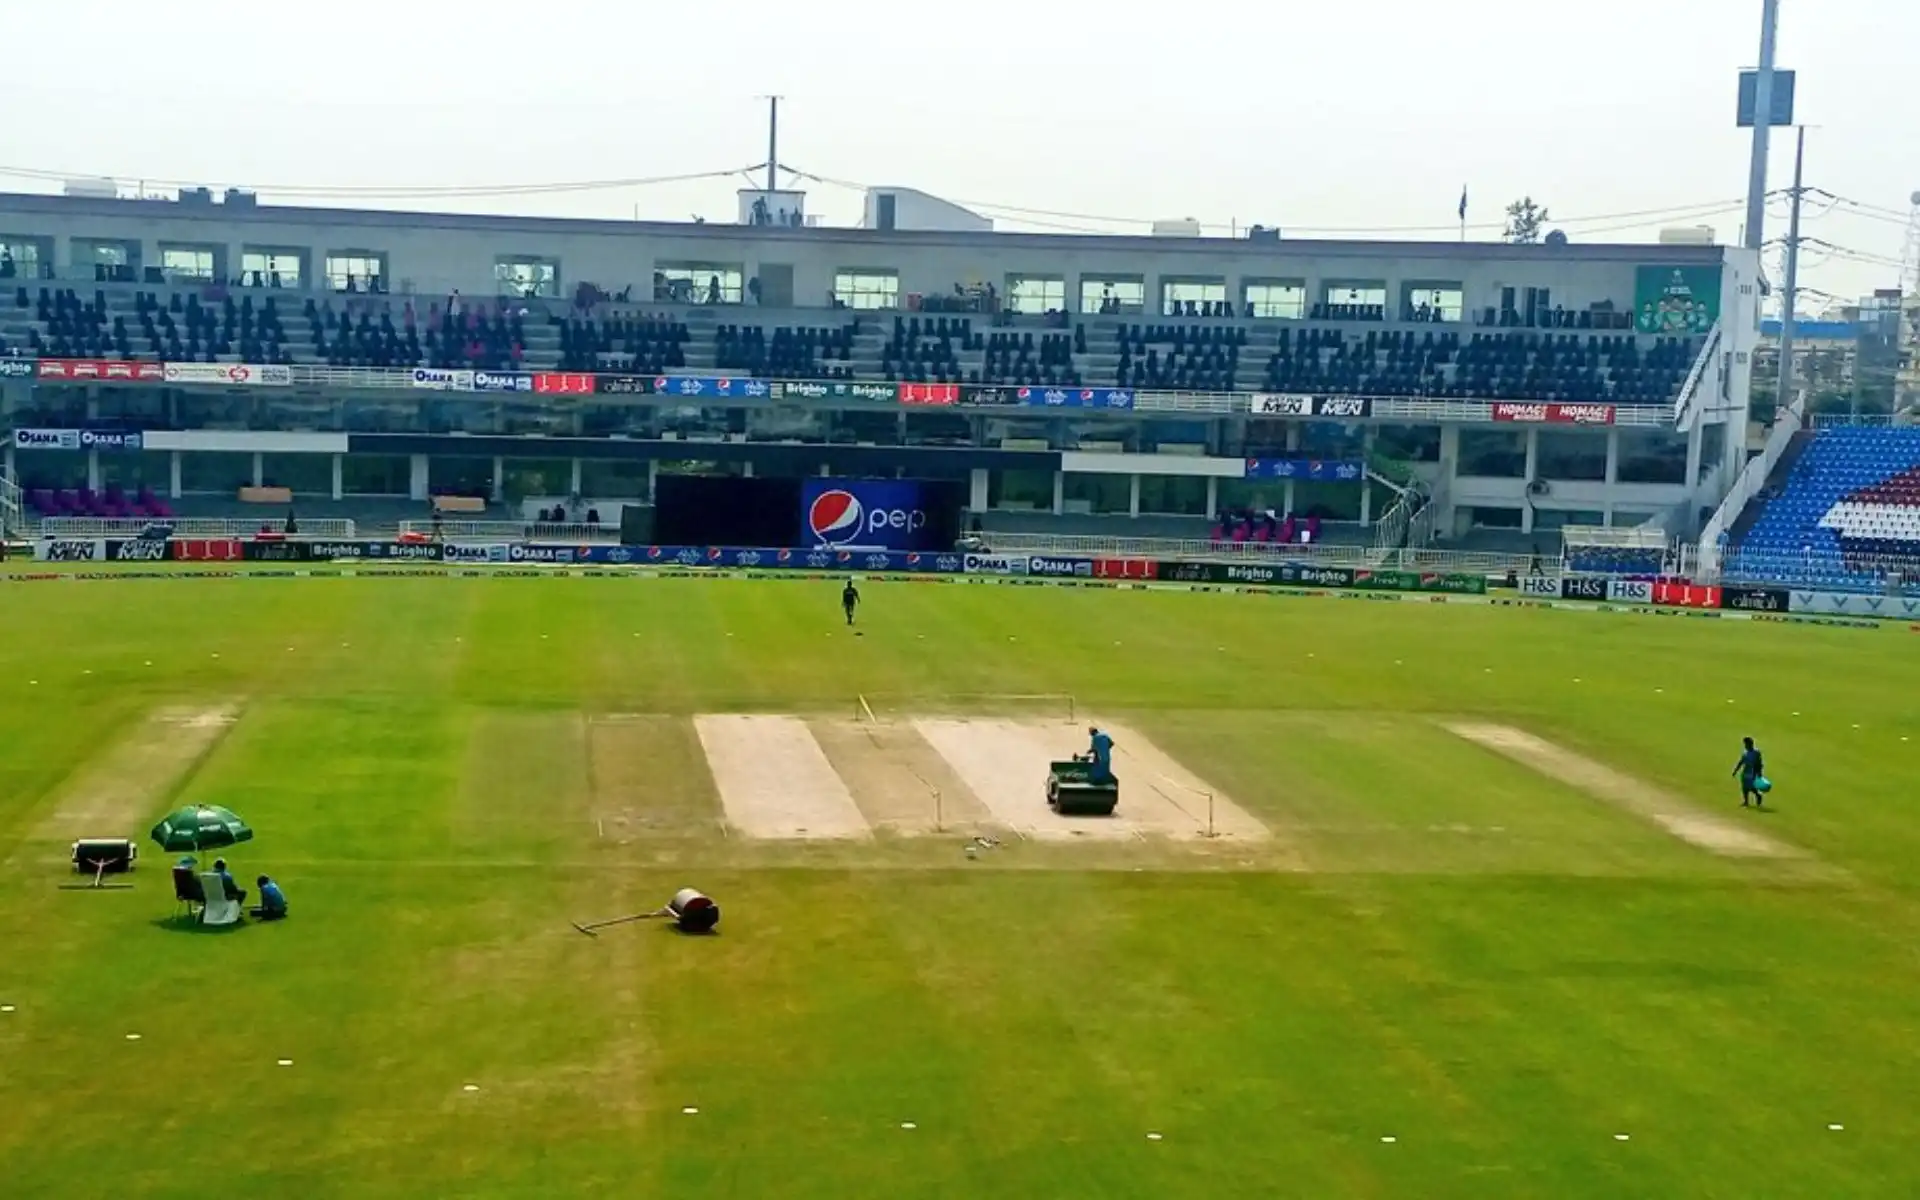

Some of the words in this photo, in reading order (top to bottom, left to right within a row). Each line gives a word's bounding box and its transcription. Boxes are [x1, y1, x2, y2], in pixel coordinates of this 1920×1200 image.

[389, 544, 436, 557] Brighto
[1227, 567, 1273, 580] Brighto
[1300, 569, 1347, 582] Brighto
[1523, 579, 1556, 593] H&S
[1568, 580, 1601, 595] H&S
[1613, 582, 1646, 598] H&S
